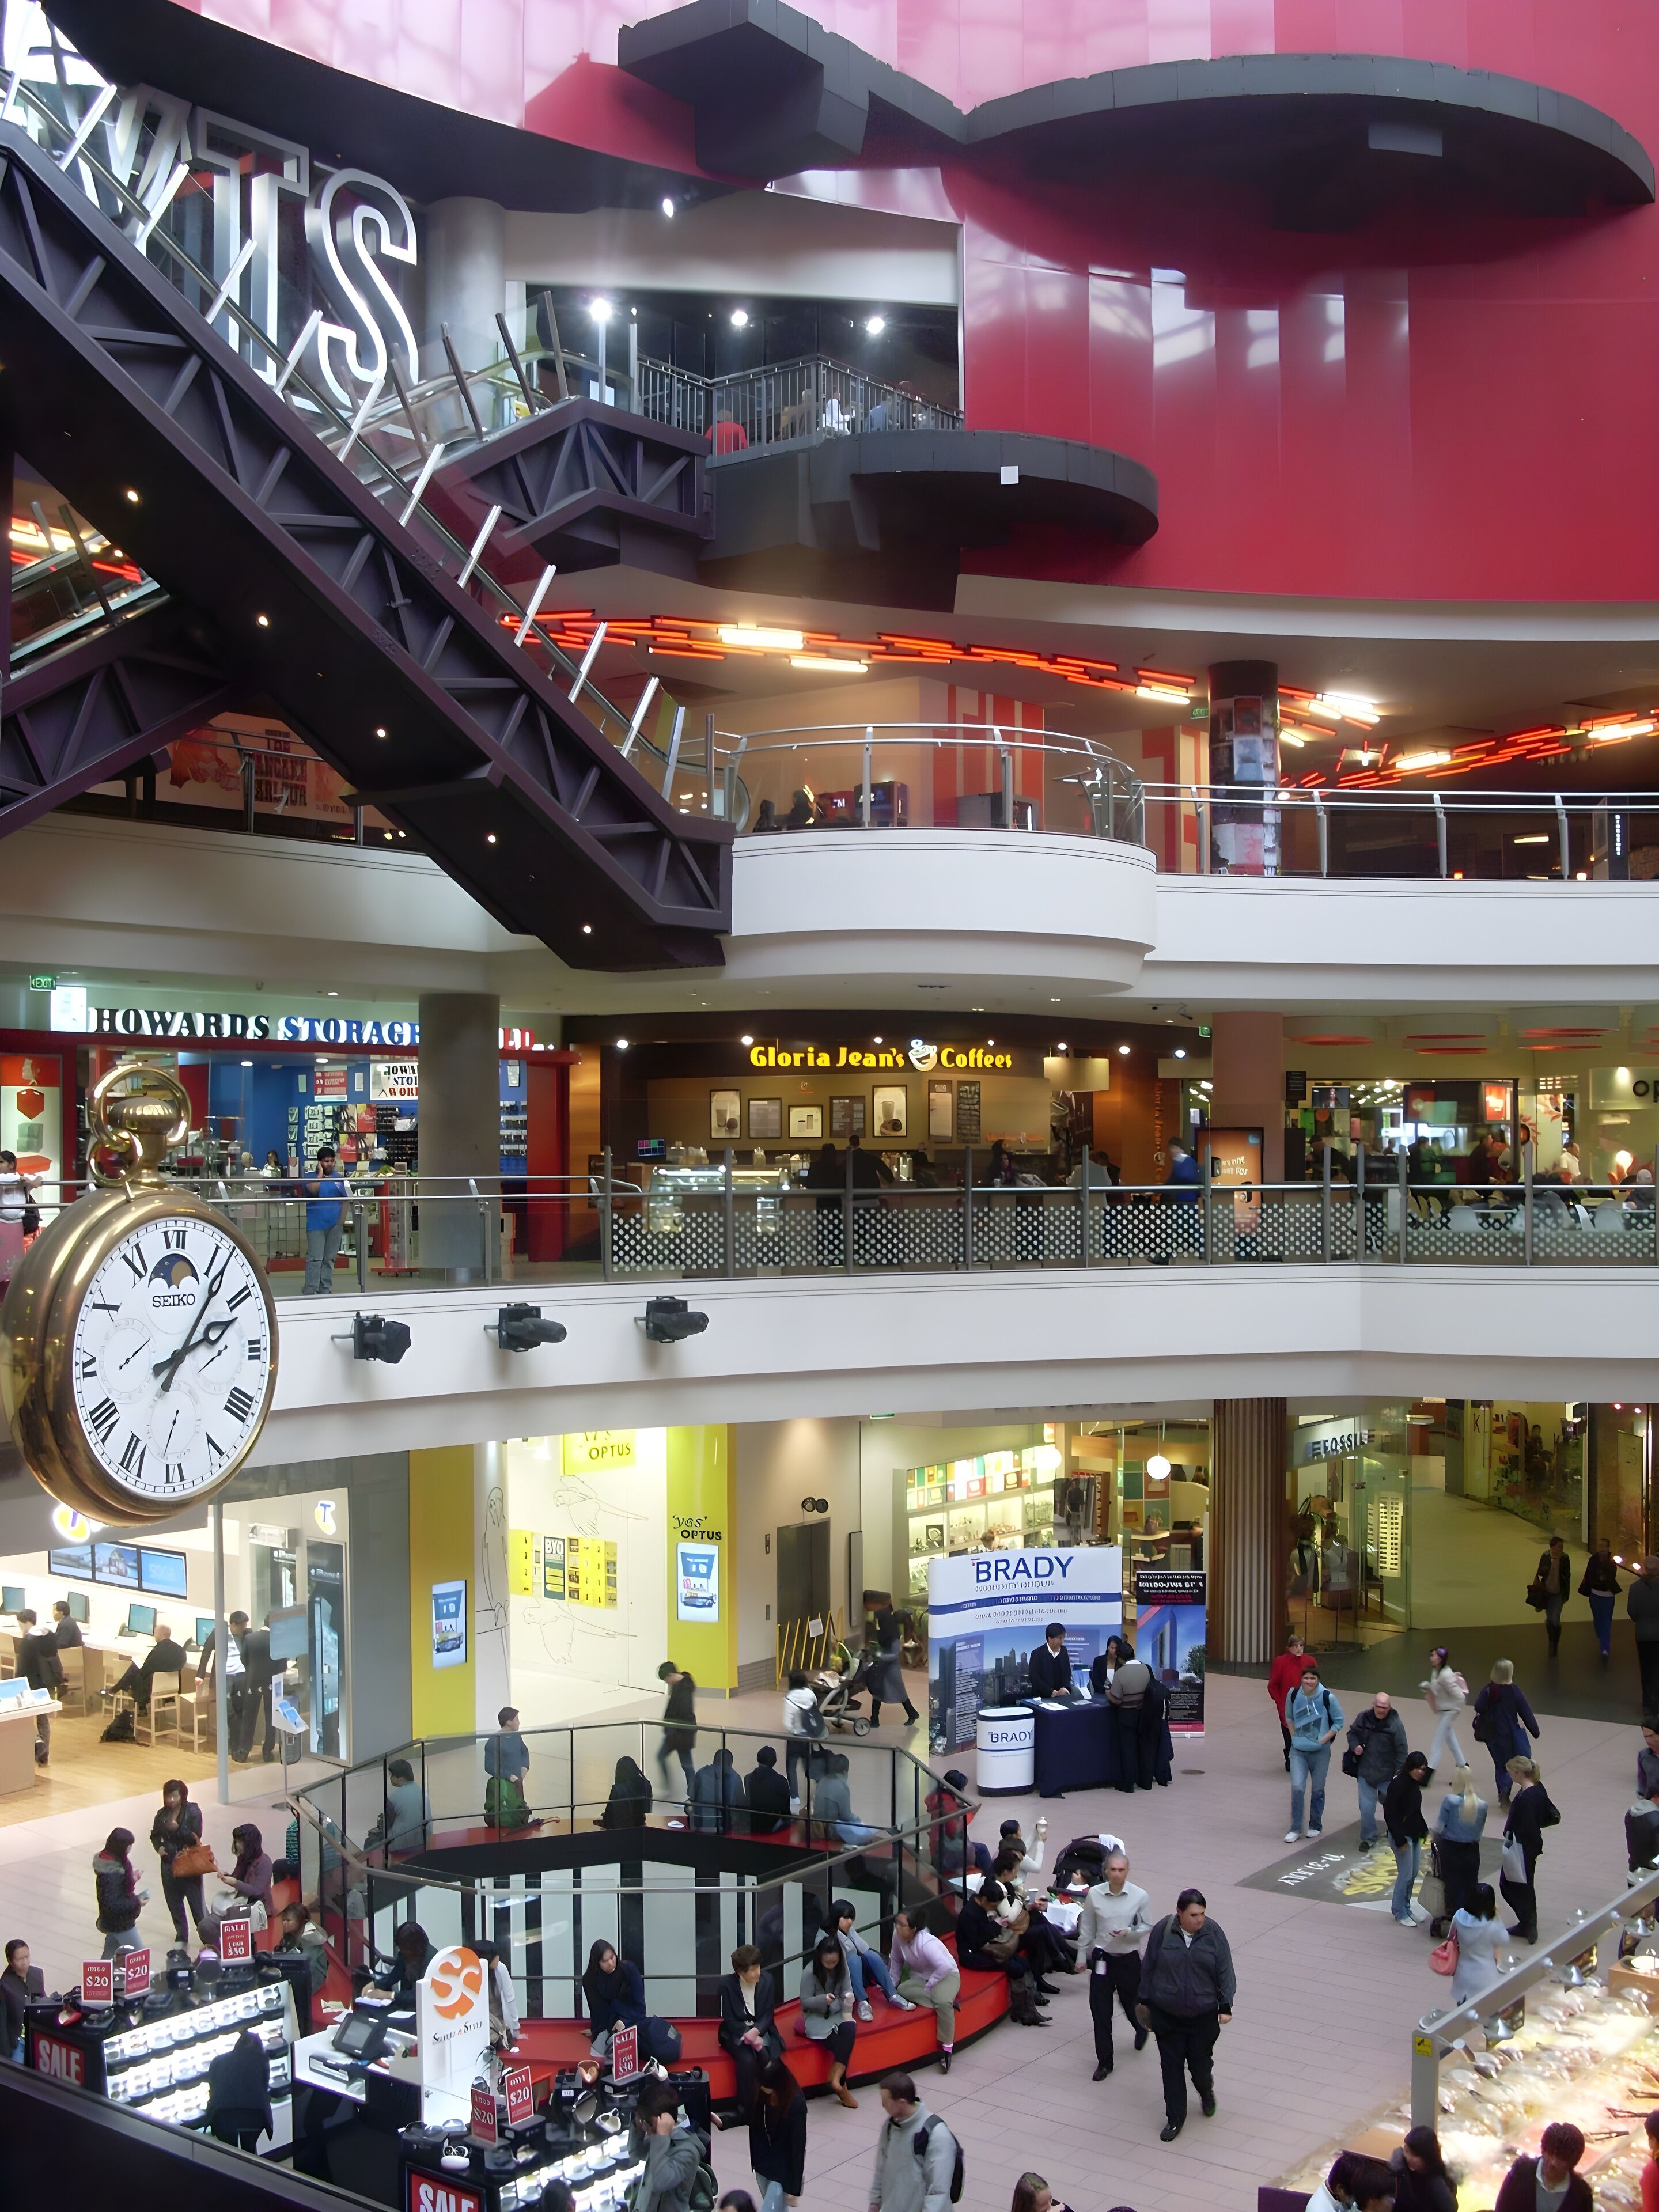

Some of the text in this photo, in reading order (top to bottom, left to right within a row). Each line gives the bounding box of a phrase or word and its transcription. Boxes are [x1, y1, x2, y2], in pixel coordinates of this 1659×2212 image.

[88, 1007, 270, 1039] HOWARDS
[750, 1046, 1012, 1069] Gloria Jean's Coffees
[152, 1293, 196, 1308] SEIKO
[589, 1442, 631, 1460] OPTUS
[681, 1529, 722, 1540] OPTUS
[545, 1538, 564, 1555] BYO
[976, 1556, 1074, 1584] BRADY
[128, 1964, 147, 1980] $20
[86, 1976, 108, 1987] $20
[39, 2040, 81, 2085] SALE
[510, 2086, 530, 2107] $20
